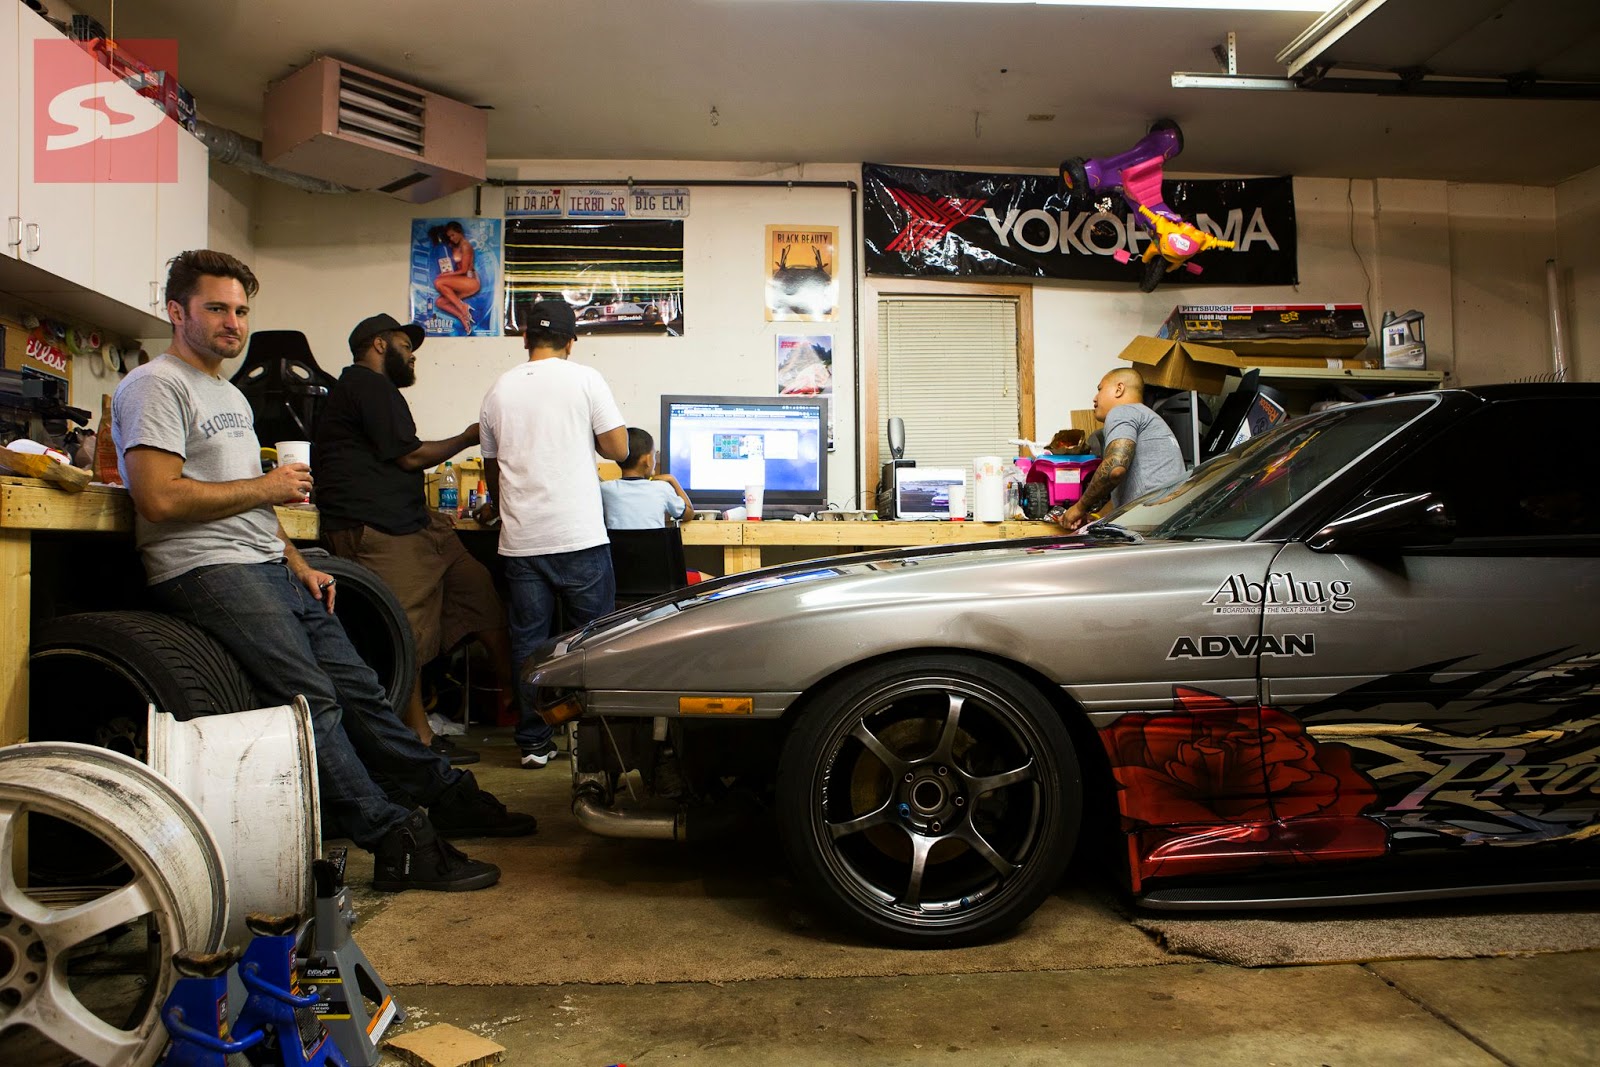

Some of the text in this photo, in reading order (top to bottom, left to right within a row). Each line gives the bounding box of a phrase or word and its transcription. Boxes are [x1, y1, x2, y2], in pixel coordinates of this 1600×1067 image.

[507, 196, 561, 210] HT DA APX
[611, 197, 625, 211] SR
[663, 196, 684, 210] ELM
[778, 234, 828, 244] BLACK BEAUTY
[984, 206, 1281, 256] YOKOHMA
[200, 412, 253, 439] HOBBIES
[1203, 571, 1356, 612] Abflug
[1166, 633, 1315, 660] ADVAN
[1384, 749, 1600, 811] PRO
